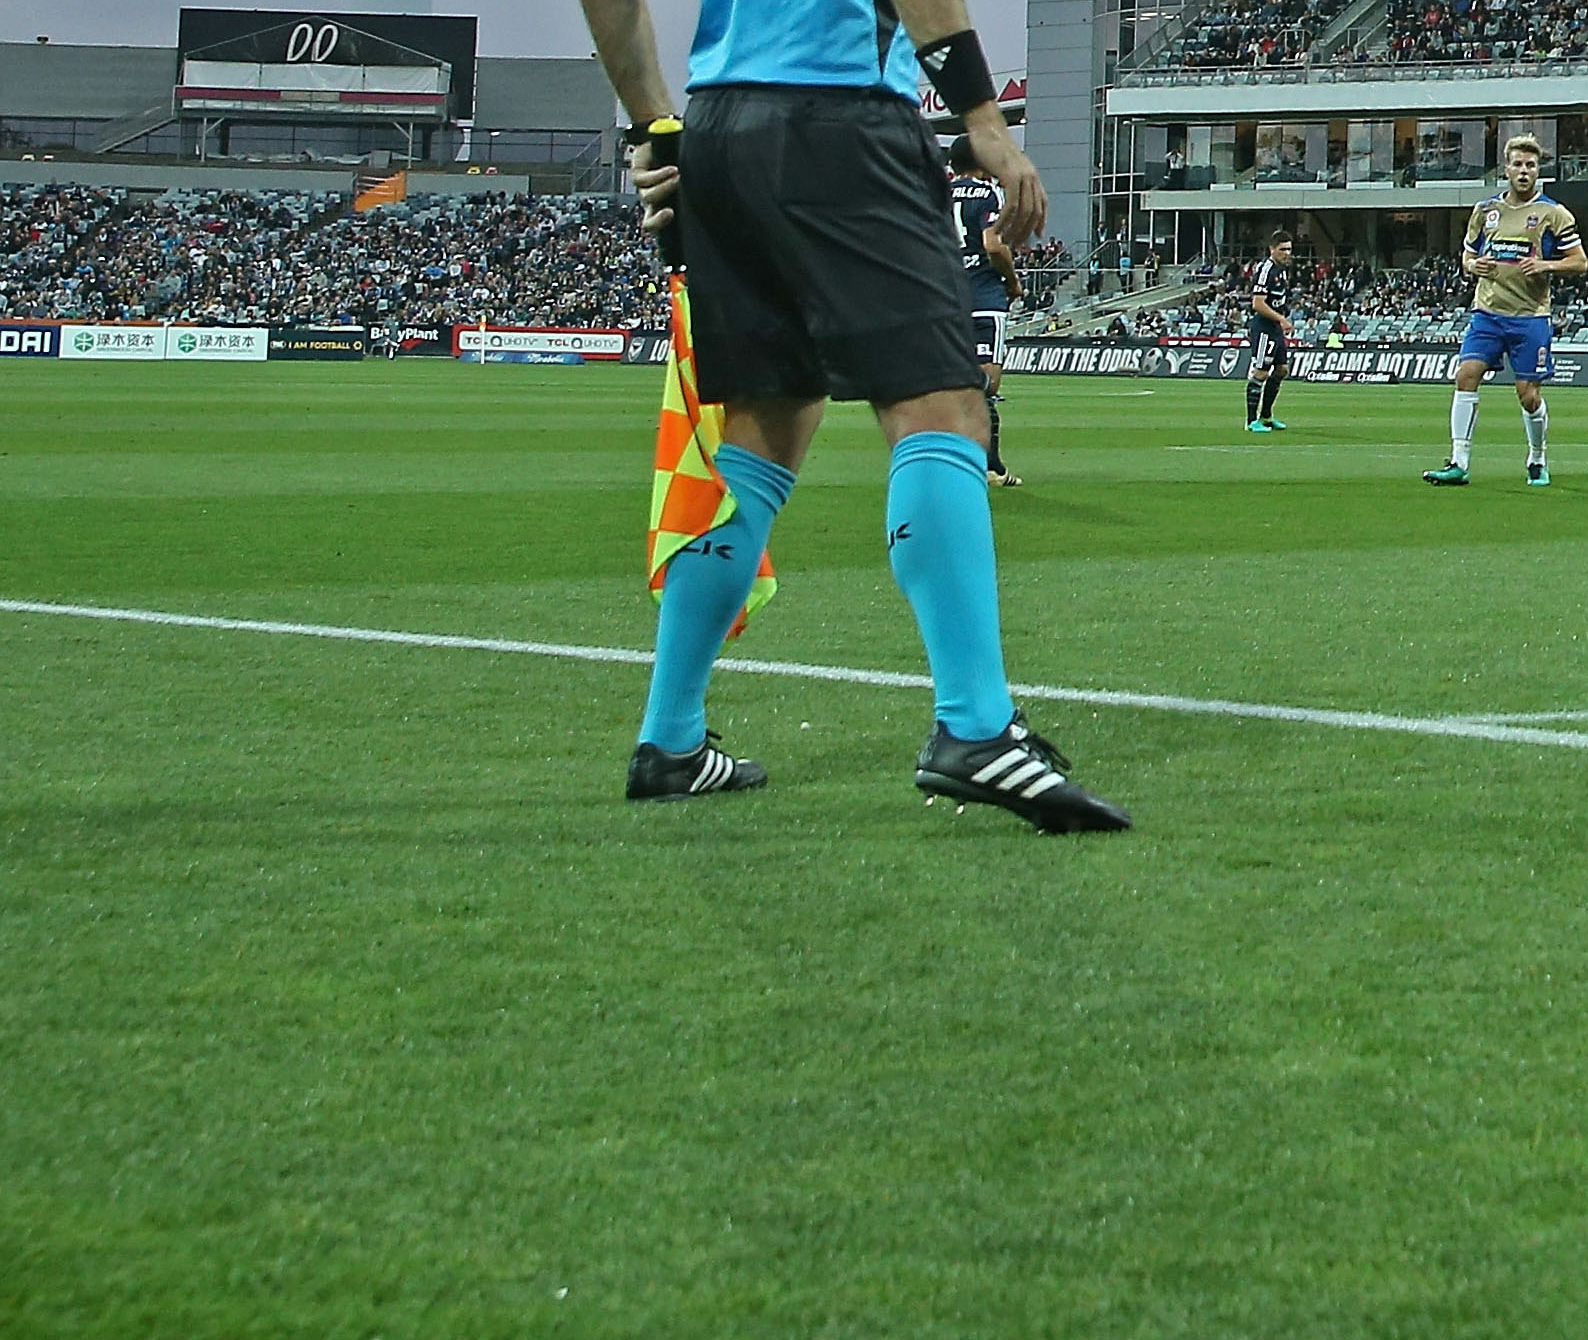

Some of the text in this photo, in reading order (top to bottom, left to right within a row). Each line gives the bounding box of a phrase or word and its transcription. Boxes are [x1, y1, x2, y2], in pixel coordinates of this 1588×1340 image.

[951, 186, 991, 199] ALLAH
[1002, 347, 1143, 373] AME, NOT THE ODDS
[1291, 351, 1325, 377] THE
[1376, 352, 1412, 379] NOT
[1411, 353, 1444, 380] THE
